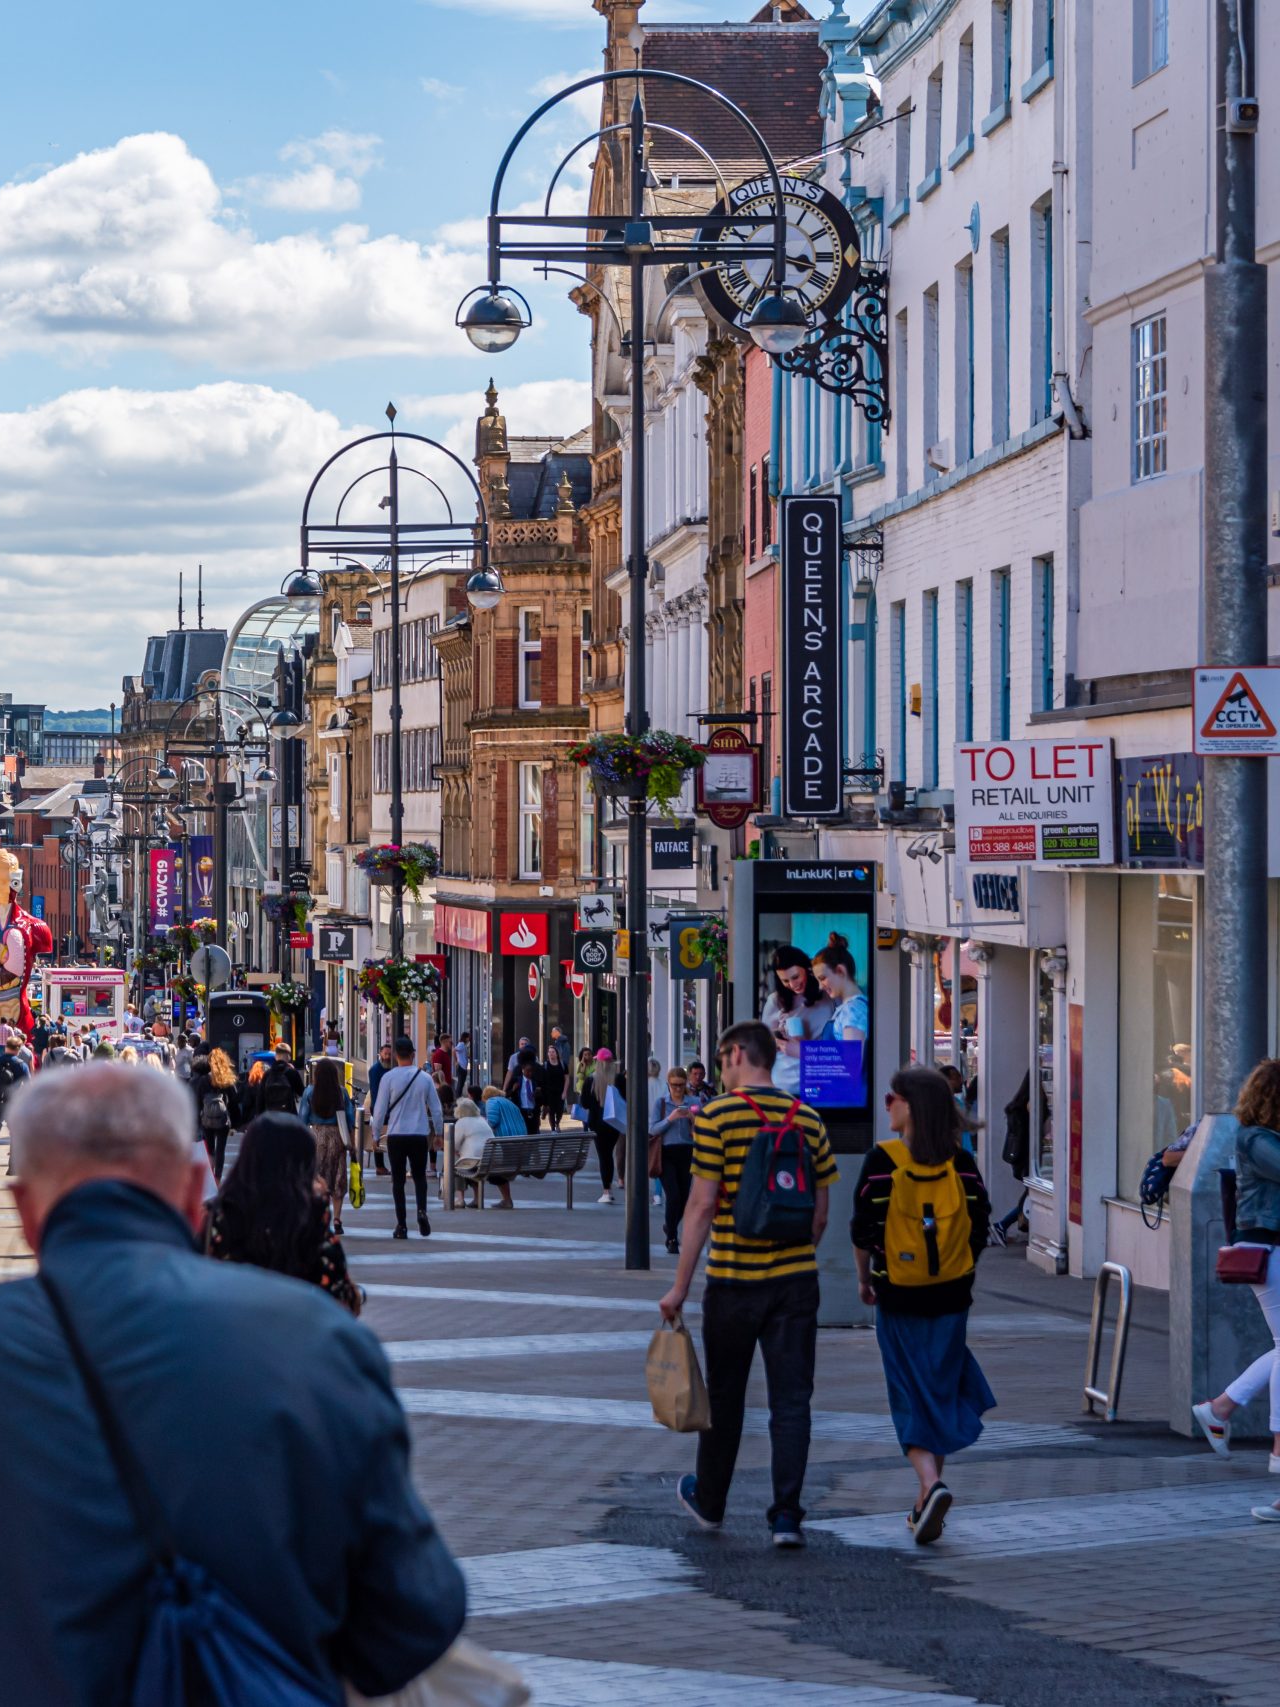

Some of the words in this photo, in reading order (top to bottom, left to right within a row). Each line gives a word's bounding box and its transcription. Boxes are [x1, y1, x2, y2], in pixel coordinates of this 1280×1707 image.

[736, 178, 822, 202] QUEN'S
[802, 513, 827, 651] QUEEN'S
[1216, 710, 1261, 722] CCTV
[802, 661, 823, 800] ARCADE
[714, 739, 741, 748] SHIP
[960, 746, 1015, 782] TO
[1030, 744, 1104, 780] LET
[972, 786, 1040, 806] RETAIL
[1048, 785, 1095, 804] UNIT
[1126, 780, 1142, 850] of
[1152, 764, 1202, 843] Wiza
[998, 812, 1014, 820] ALL
[1018, 810, 1068, 820] ENQUIRIES
[654, 841, 689, 852] FATFACE
[970, 843, 990, 852] 0113
[993, 842, 1010, 852] 388
[1012, 842, 1035, 851] 4848
[1044, 840, 1056, 848] 020
[1079, 838, 1098, 847] 4848
[786, 869, 832, 880] InLinkUK
[156, 860, 168, 917] #CWC19
[820, 1046, 838, 1054] home,
